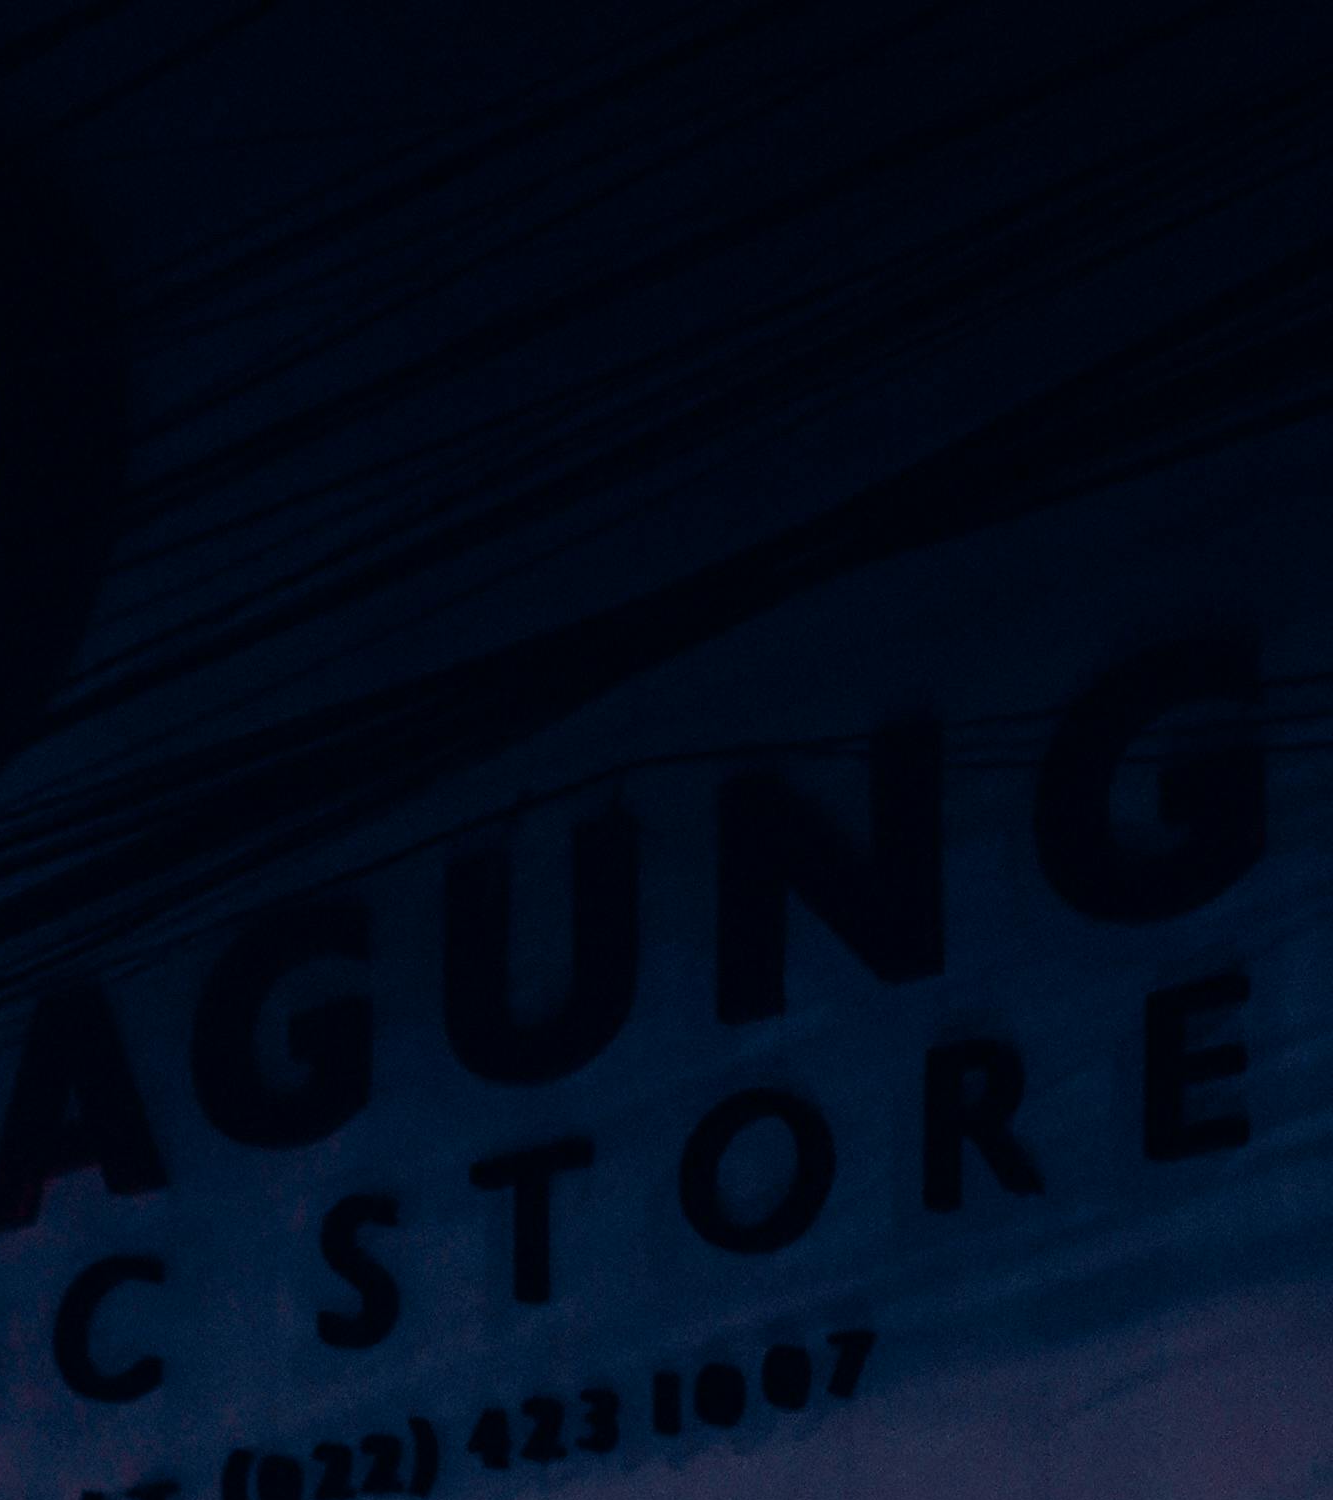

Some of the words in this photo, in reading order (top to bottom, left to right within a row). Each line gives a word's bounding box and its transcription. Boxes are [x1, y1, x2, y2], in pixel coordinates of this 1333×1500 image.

[320, 970, 1254, 1350] STORE
[467, 1387, 621, 1471] 423
[651, 1330, 879, 1438] 1007
